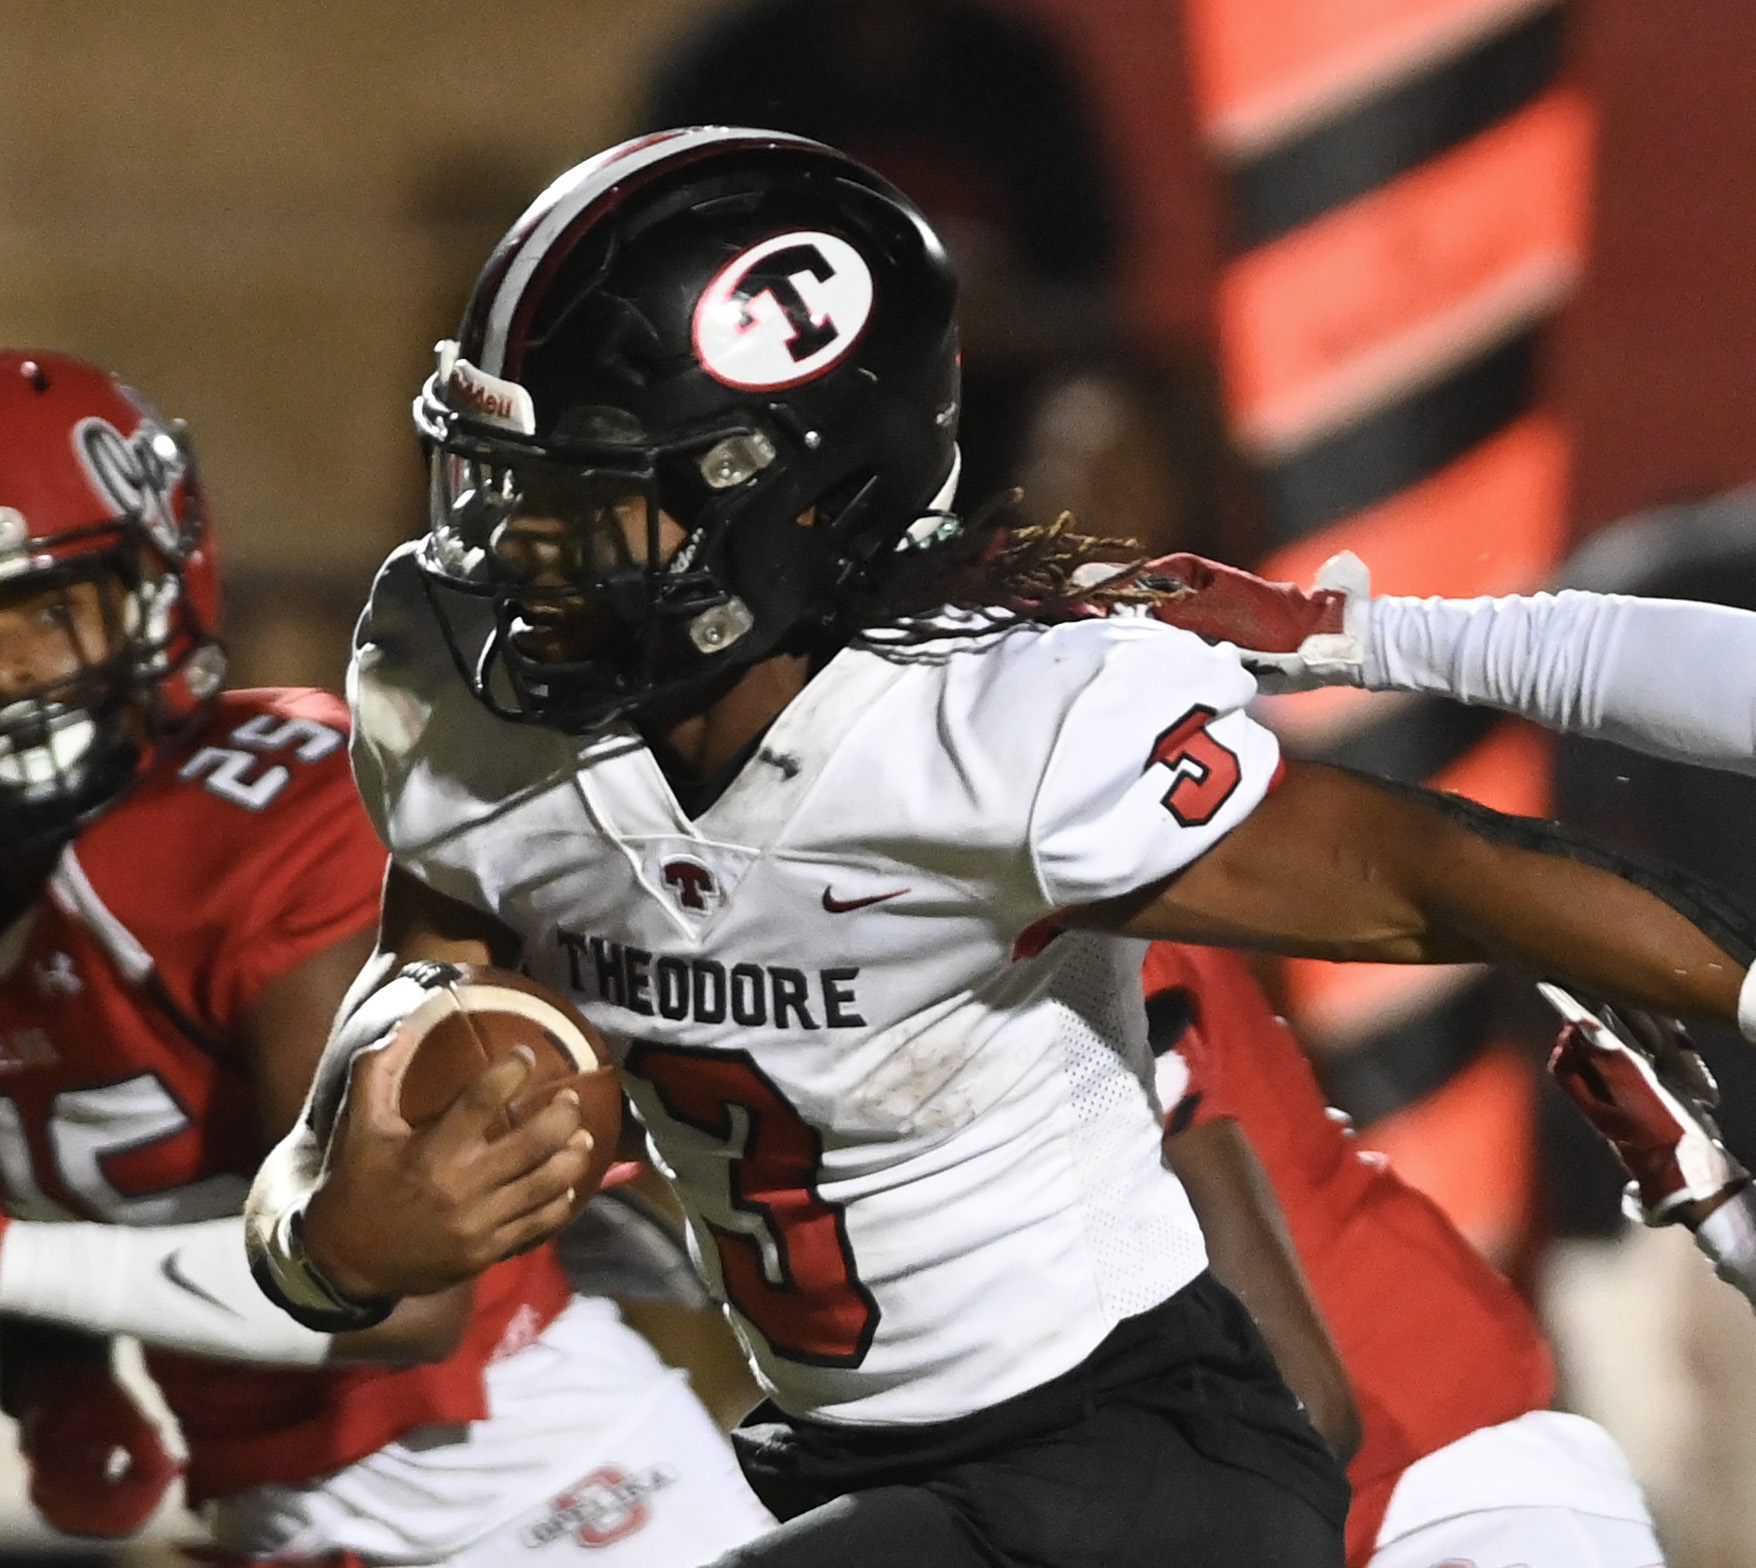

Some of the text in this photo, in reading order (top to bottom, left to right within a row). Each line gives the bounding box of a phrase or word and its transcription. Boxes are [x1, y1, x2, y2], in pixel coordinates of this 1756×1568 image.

[730, 243, 837, 363] T
[177, 714, 343, 811] 25
[660, 857, 720, 913] T
[556, 924, 868, 1030] THEODORE
[0, 1068, 247, 1224] 5
[624, 1042, 882, 1369] 3
